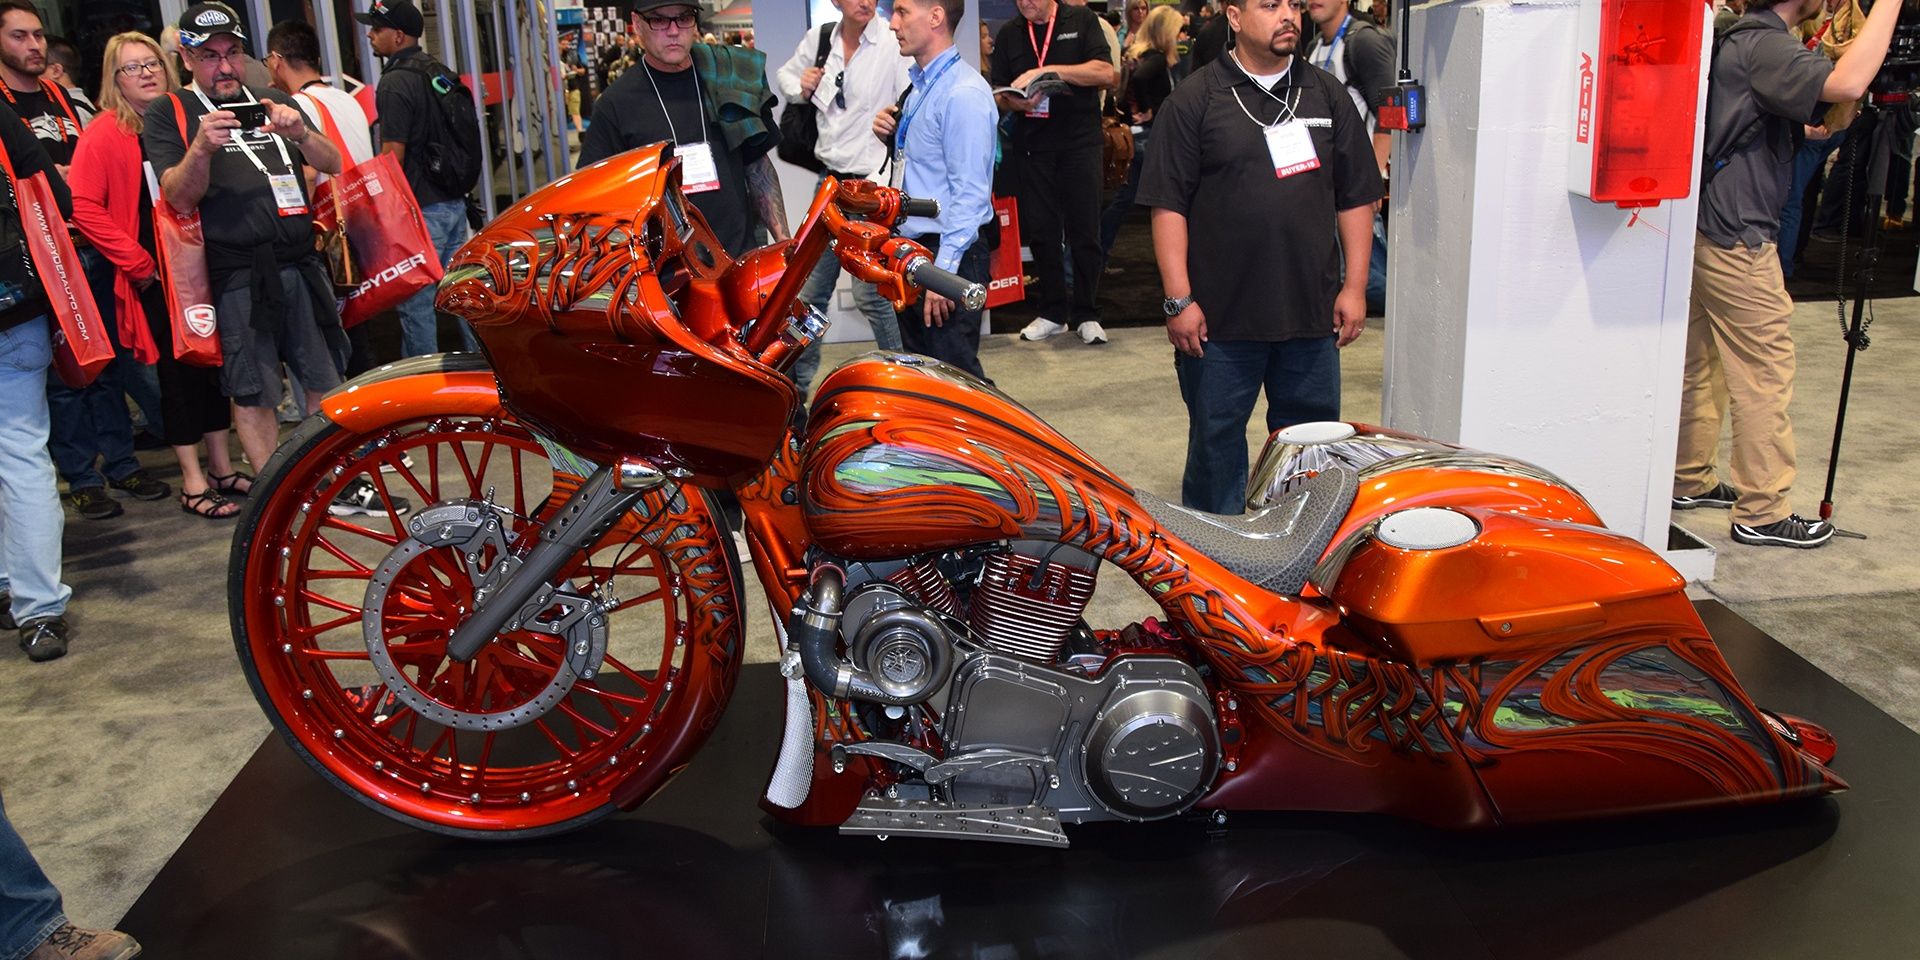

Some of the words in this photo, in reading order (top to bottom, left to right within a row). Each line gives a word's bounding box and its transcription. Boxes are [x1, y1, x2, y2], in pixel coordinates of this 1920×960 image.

[199, 11, 226, 24] NHRA
[1579, 76, 1591, 138] FIRE
[225, 144, 265, 153] BILLONG
[342, 172, 377, 194] LIGHTING
[32, 201, 90, 341] WWW.SPYDERAUTO.COM
[349, 253, 427, 299] SPYDER
[989, 276, 1019, 291] DER
